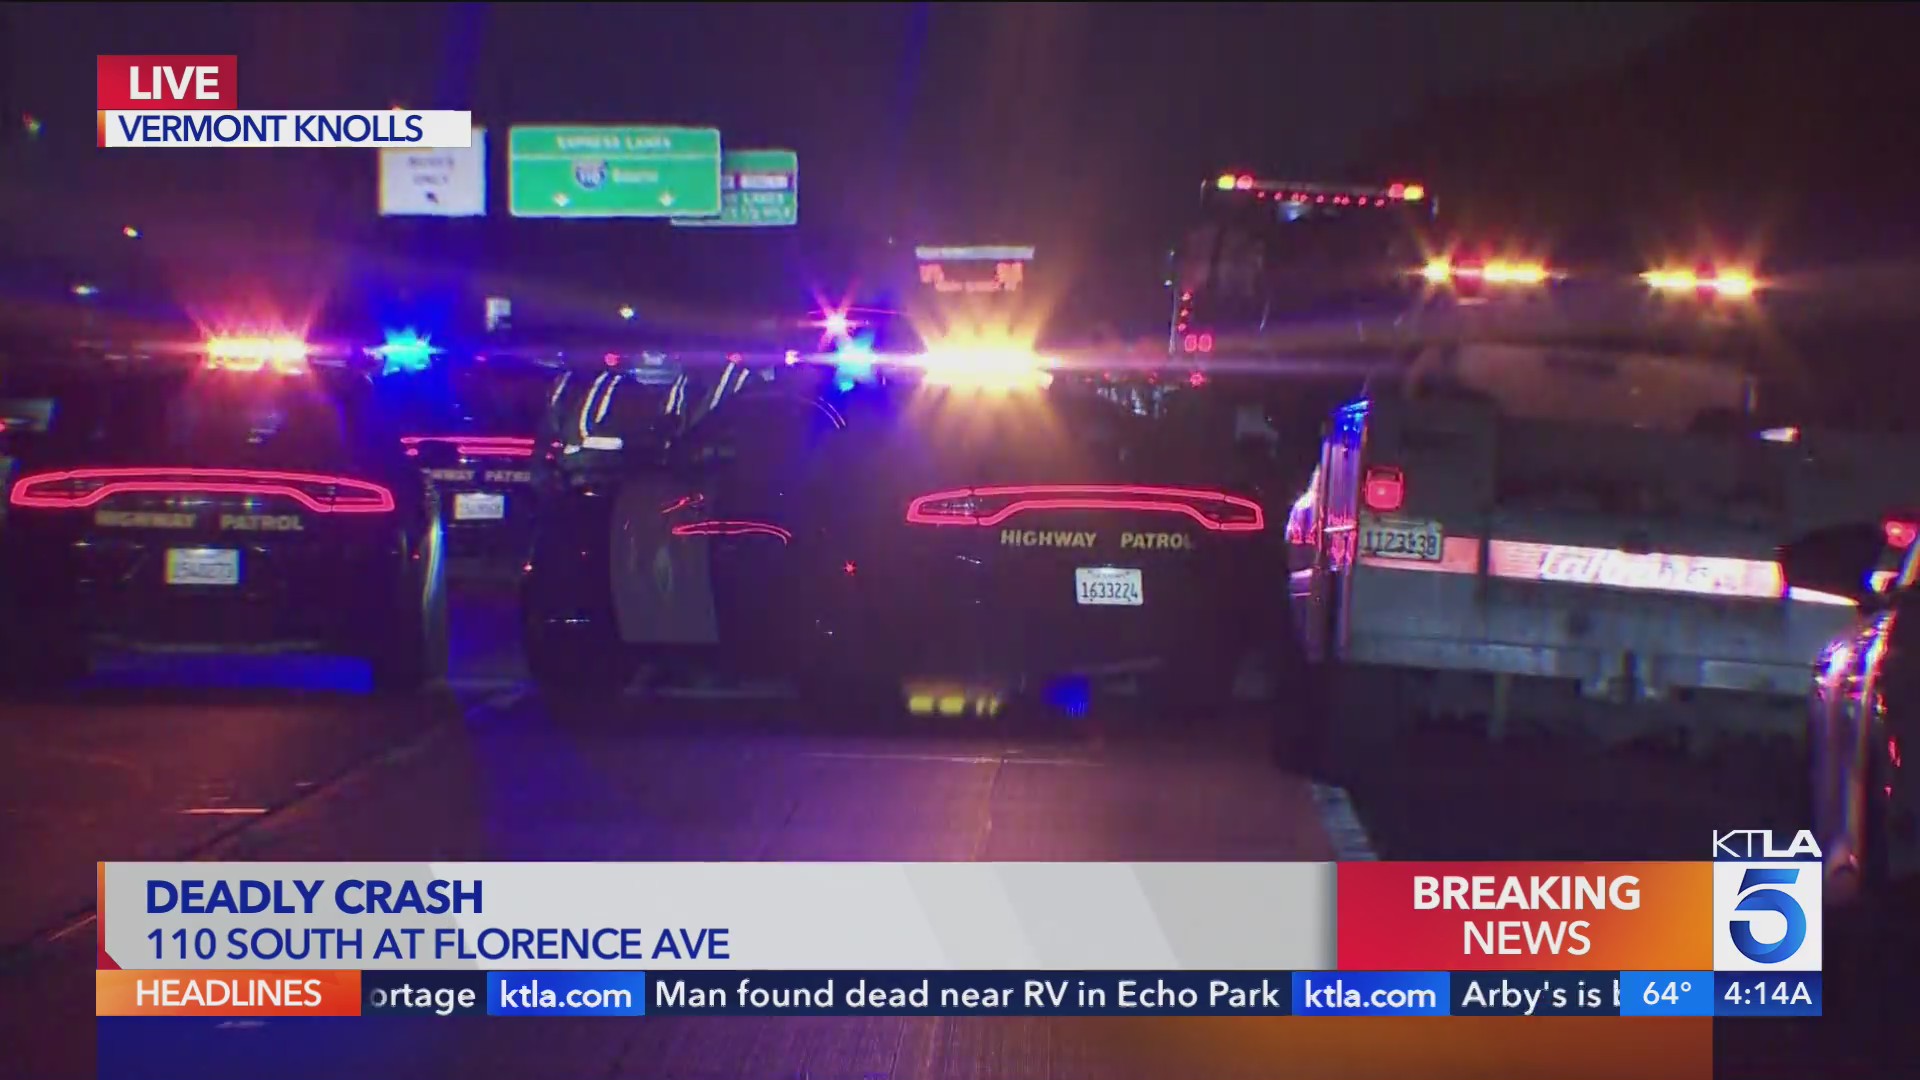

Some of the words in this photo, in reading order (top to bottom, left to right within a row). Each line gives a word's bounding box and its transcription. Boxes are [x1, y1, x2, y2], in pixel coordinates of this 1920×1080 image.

[219, 512, 303, 530] PATROL
[1000, 530, 1096, 547] HIGHWAY
[1120, 532, 1192, 549] PATROL
[1081, 582, 1138, 600] 1633224
